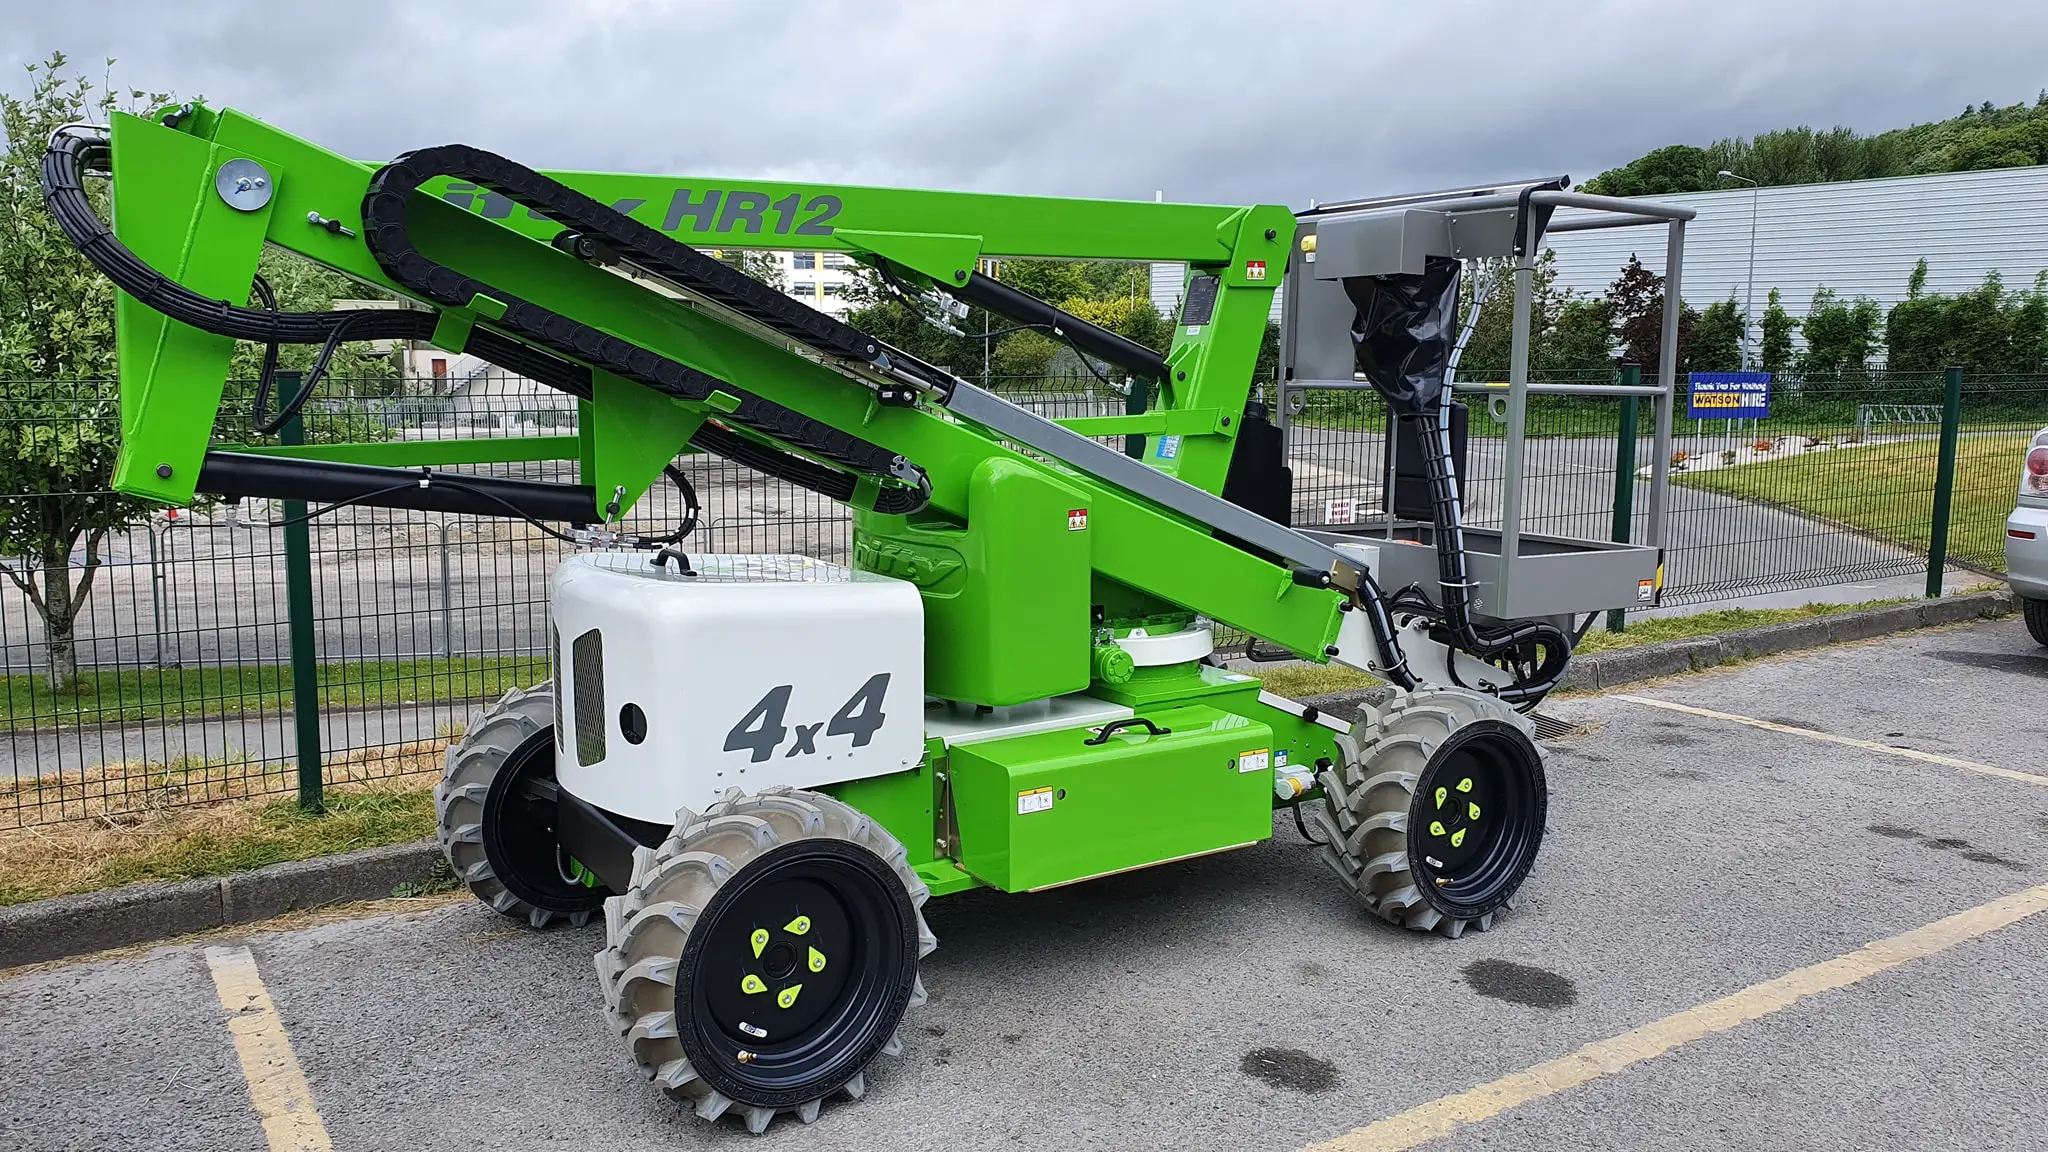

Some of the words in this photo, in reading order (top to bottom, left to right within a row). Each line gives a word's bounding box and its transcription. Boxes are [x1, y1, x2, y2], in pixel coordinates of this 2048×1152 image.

[661, 188, 843, 236] HR12
[1695, 394, 1740, 405] WATSON
[1741, 393, 1767, 408] HIRE
[723, 673, 891, 763] 4x4
